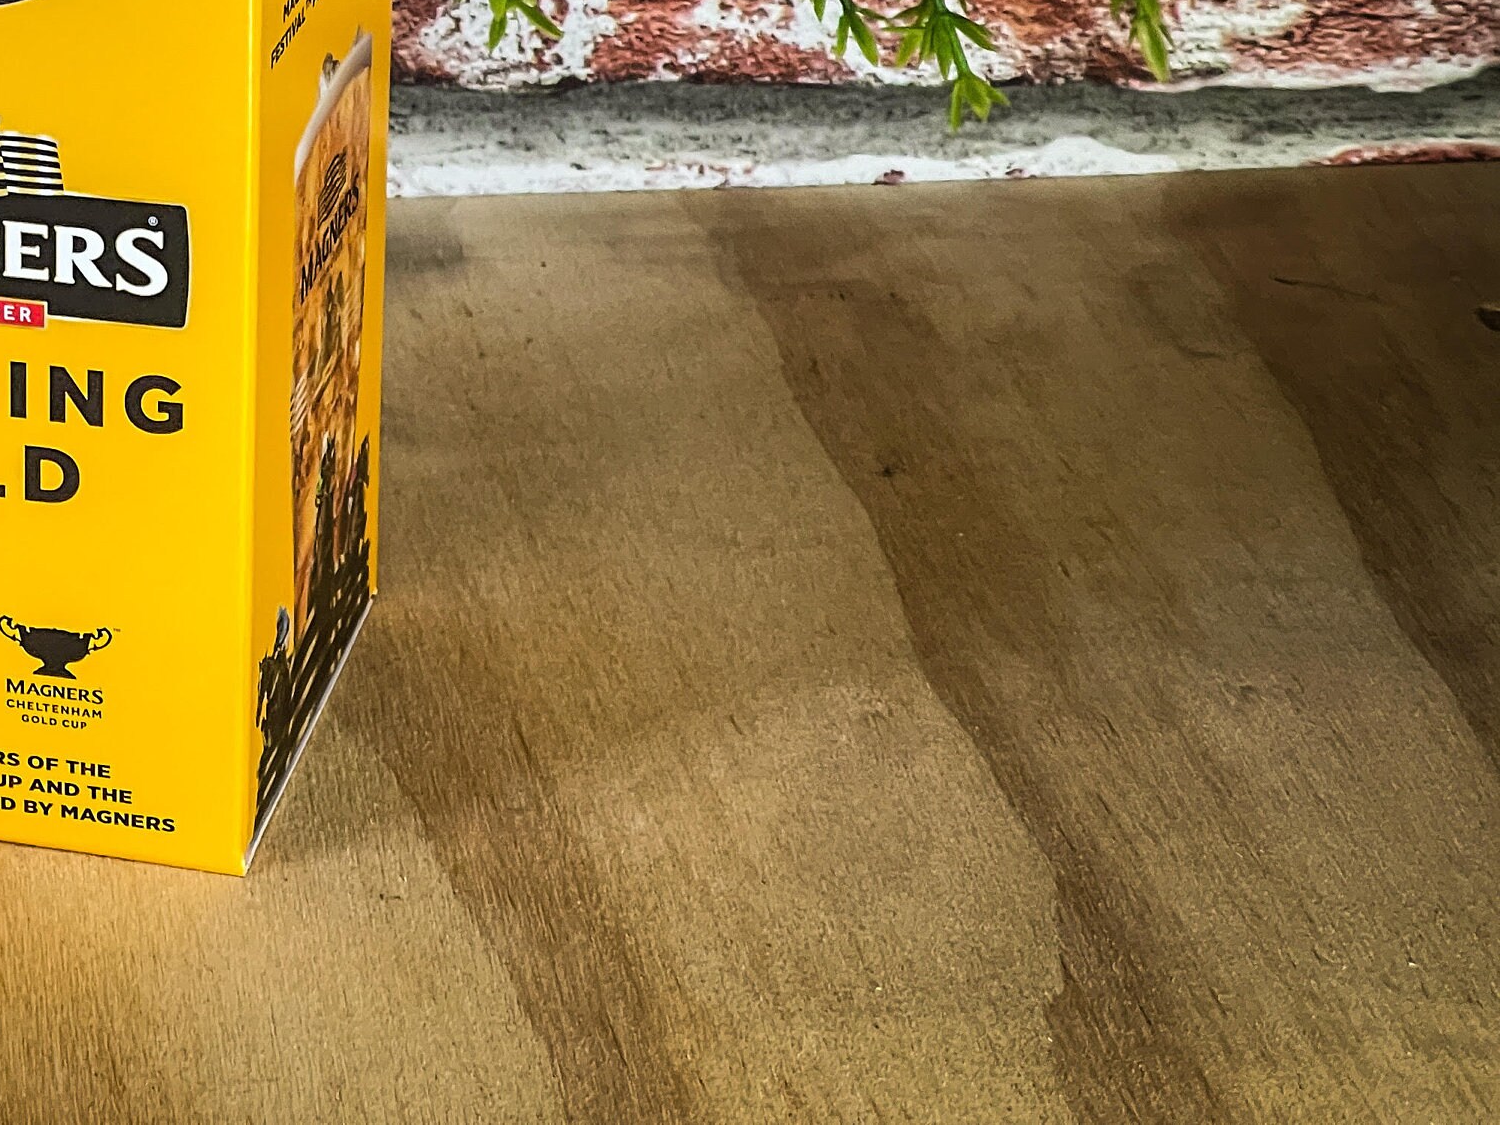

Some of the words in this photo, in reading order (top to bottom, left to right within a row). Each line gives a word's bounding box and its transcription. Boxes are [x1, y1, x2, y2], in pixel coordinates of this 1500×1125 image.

[6, 678, 104, 705] MAGNERS
[6, 698, 102, 719] CHELTENHAM
[21, 714, 57, 726] GOLD
[62, 719, 88, 729] CUP
[27, 755, 59, 771] OF
[66, 760, 111, 779] THE
[29, 778, 80, 796] AND
[87, 785, 133, 804] THE
[23, 799, 54, 816] BY
[61, 804, 176, 833] MAGNERS
